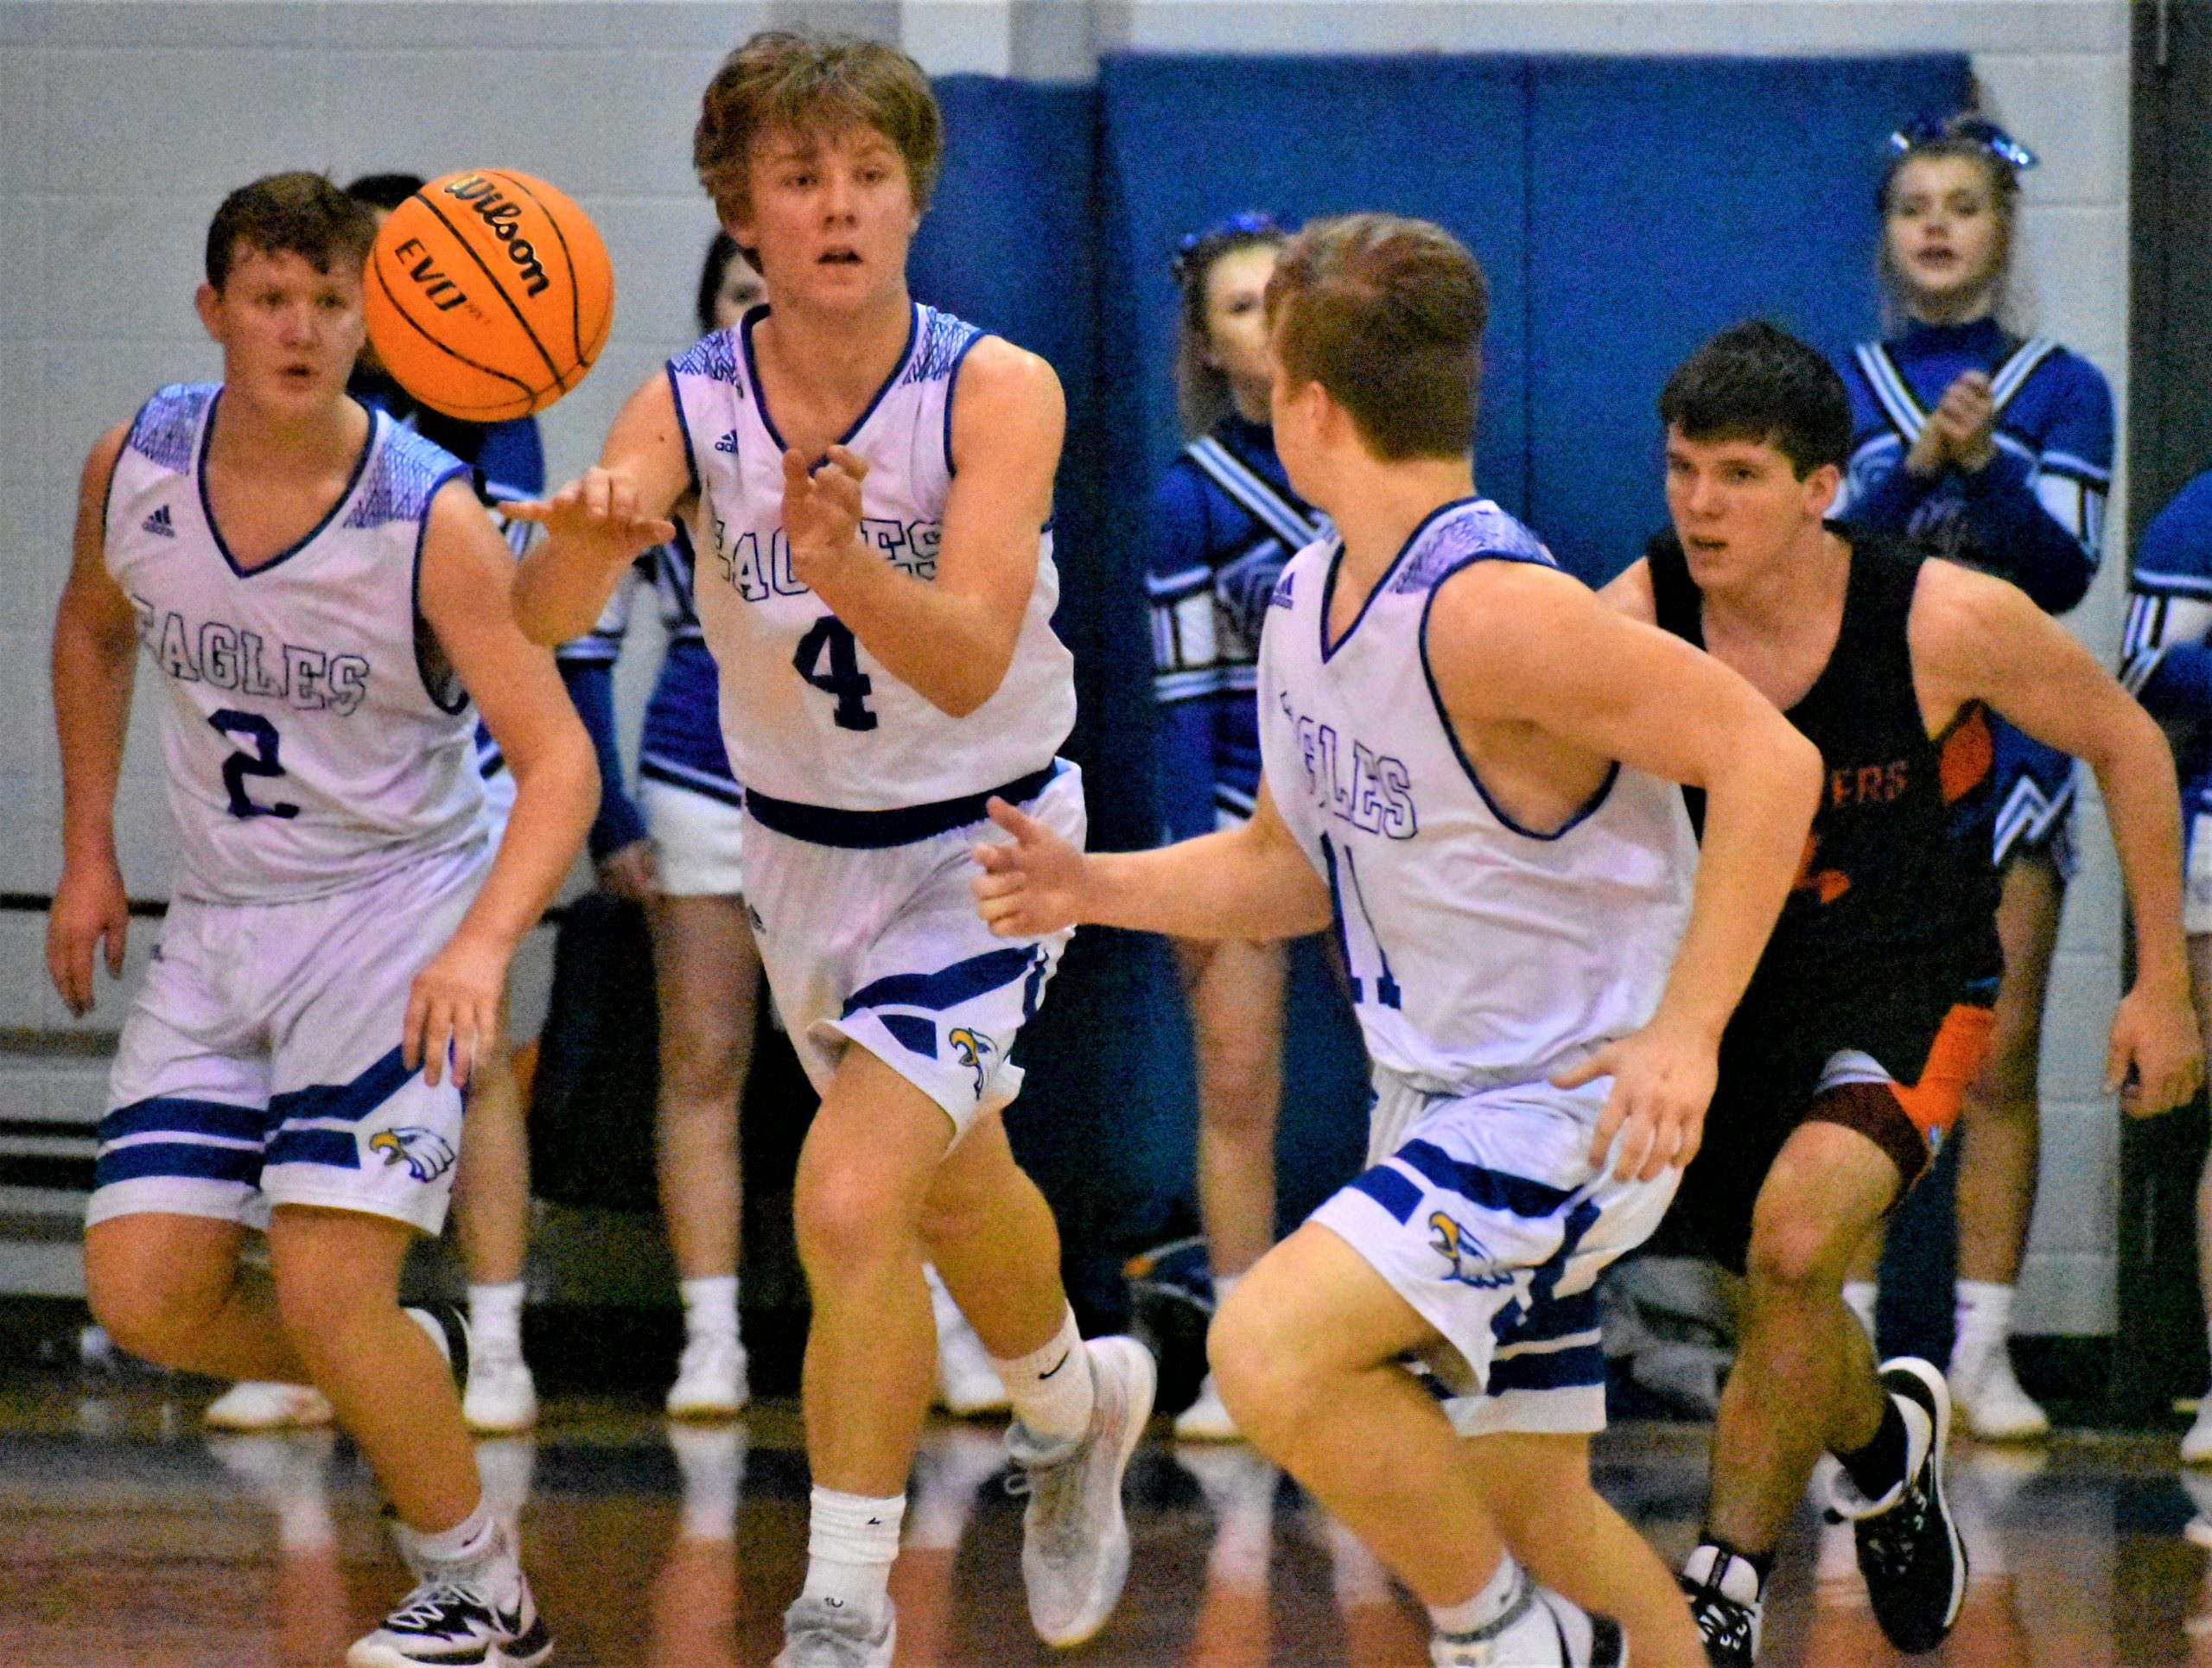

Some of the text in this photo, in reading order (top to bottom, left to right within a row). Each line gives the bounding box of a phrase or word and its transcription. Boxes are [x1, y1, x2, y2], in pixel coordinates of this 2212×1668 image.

[394, 238, 467, 311] EVO
[444, 174, 550, 296] Wilson
[792, 614, 878, 731] 4
[207, 708, 300, 819] 2
